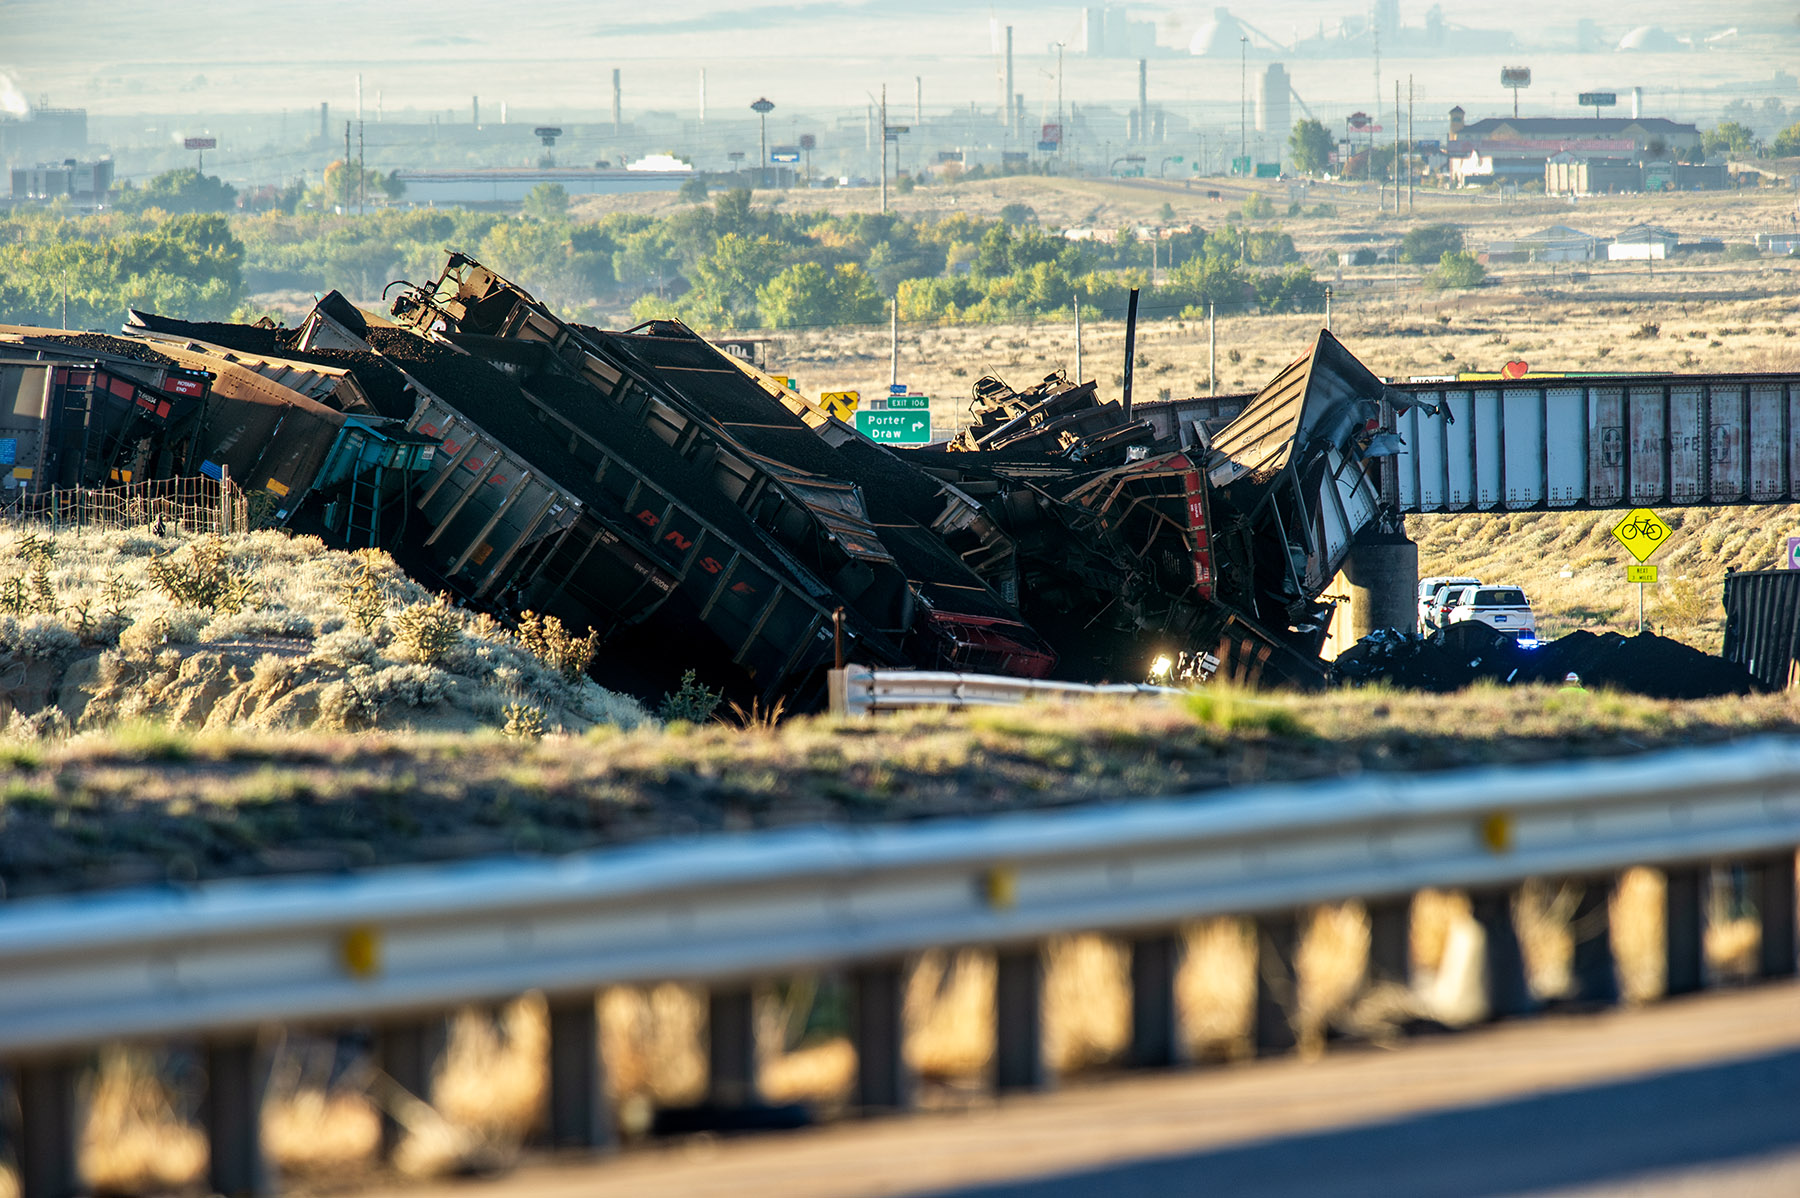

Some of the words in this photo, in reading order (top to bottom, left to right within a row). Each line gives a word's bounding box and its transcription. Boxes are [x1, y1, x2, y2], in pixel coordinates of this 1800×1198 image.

[911, 399, 925, 407] 106
[868, 415, 905, 425] Porter
[872, 429, 901, 438] Draw
[637, 509, 756, 594] BNSF
